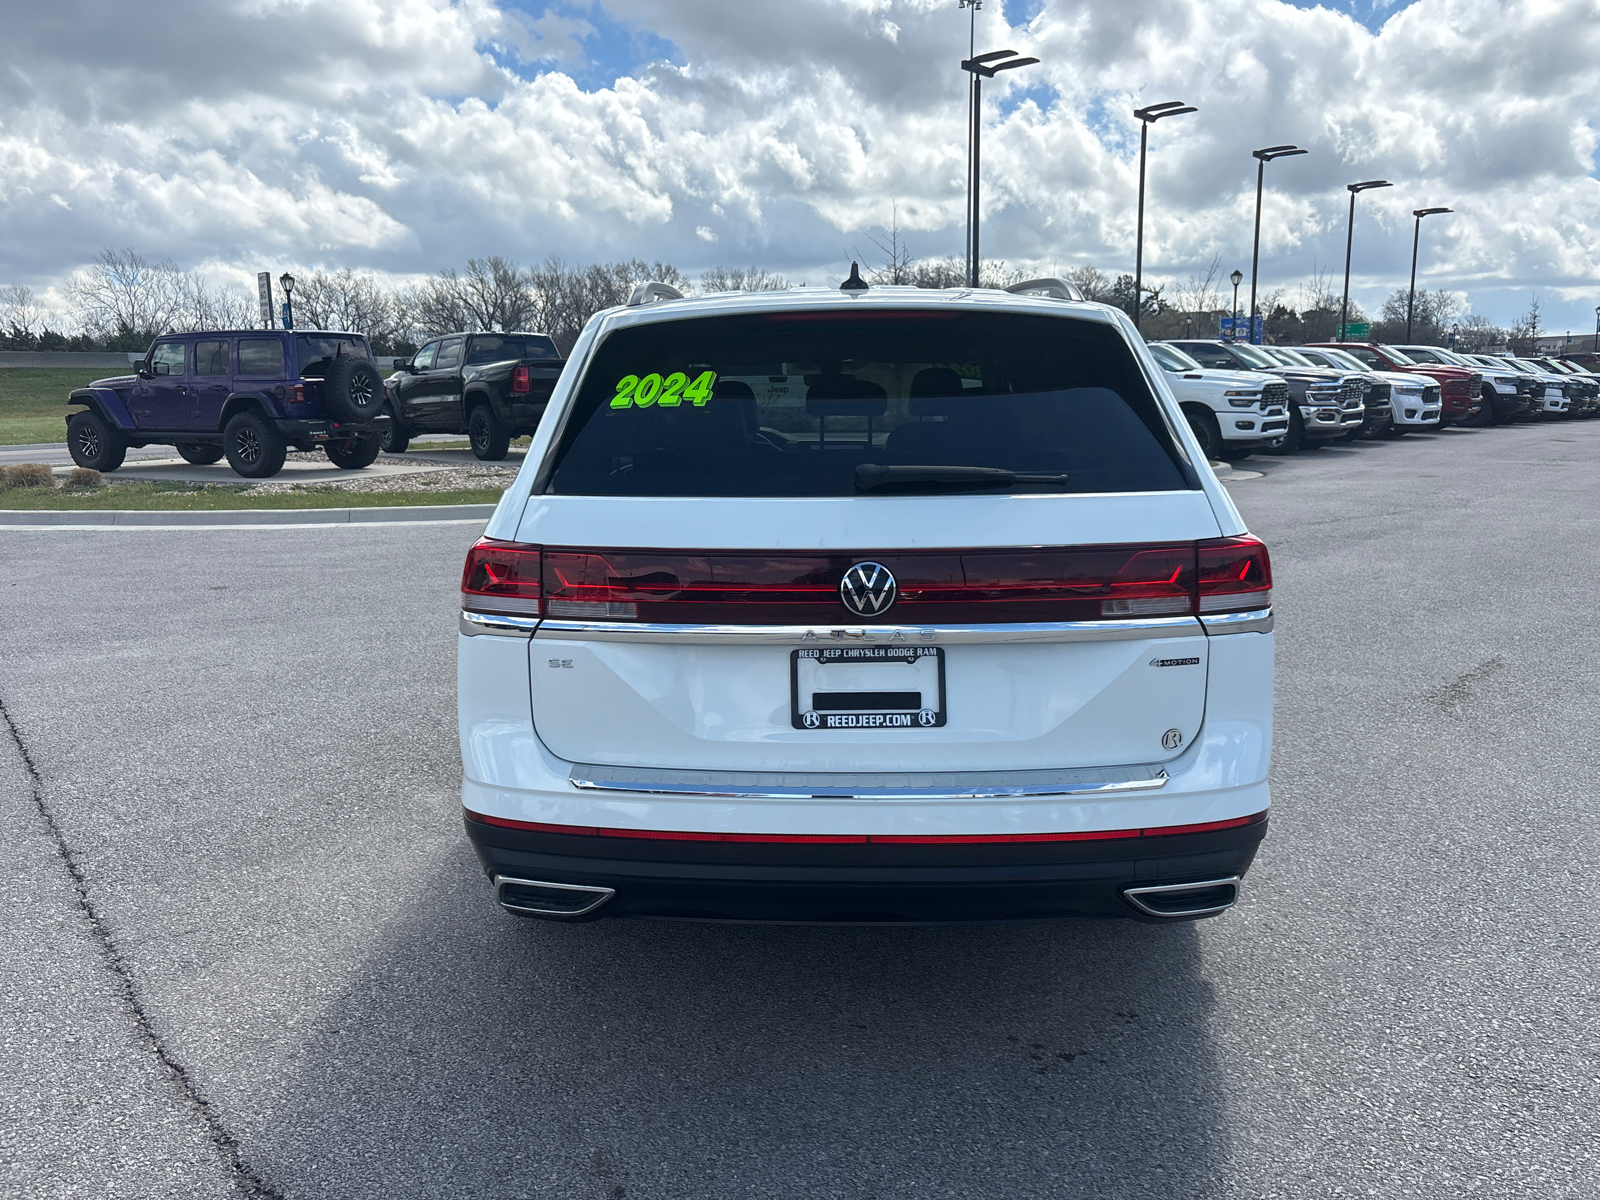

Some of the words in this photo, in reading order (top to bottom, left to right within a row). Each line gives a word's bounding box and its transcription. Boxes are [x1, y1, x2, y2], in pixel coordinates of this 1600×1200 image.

[609, 371, 717, 409] 2024
[768, 385, 789, 395] Jeep
[801, 628, 936, 642] ATLAS
[799, 649, 820, 658] REED
[823, 649, 841, 658] JEEP
[843, 648, 885, 657] CHRYSLER
[887, 648, 915, 657] DODGE
[917, 647, 937, 656] RAM
[548, 658, 574, 669] SE
[827, 714, 911, 728] REEDJEEP.COM
